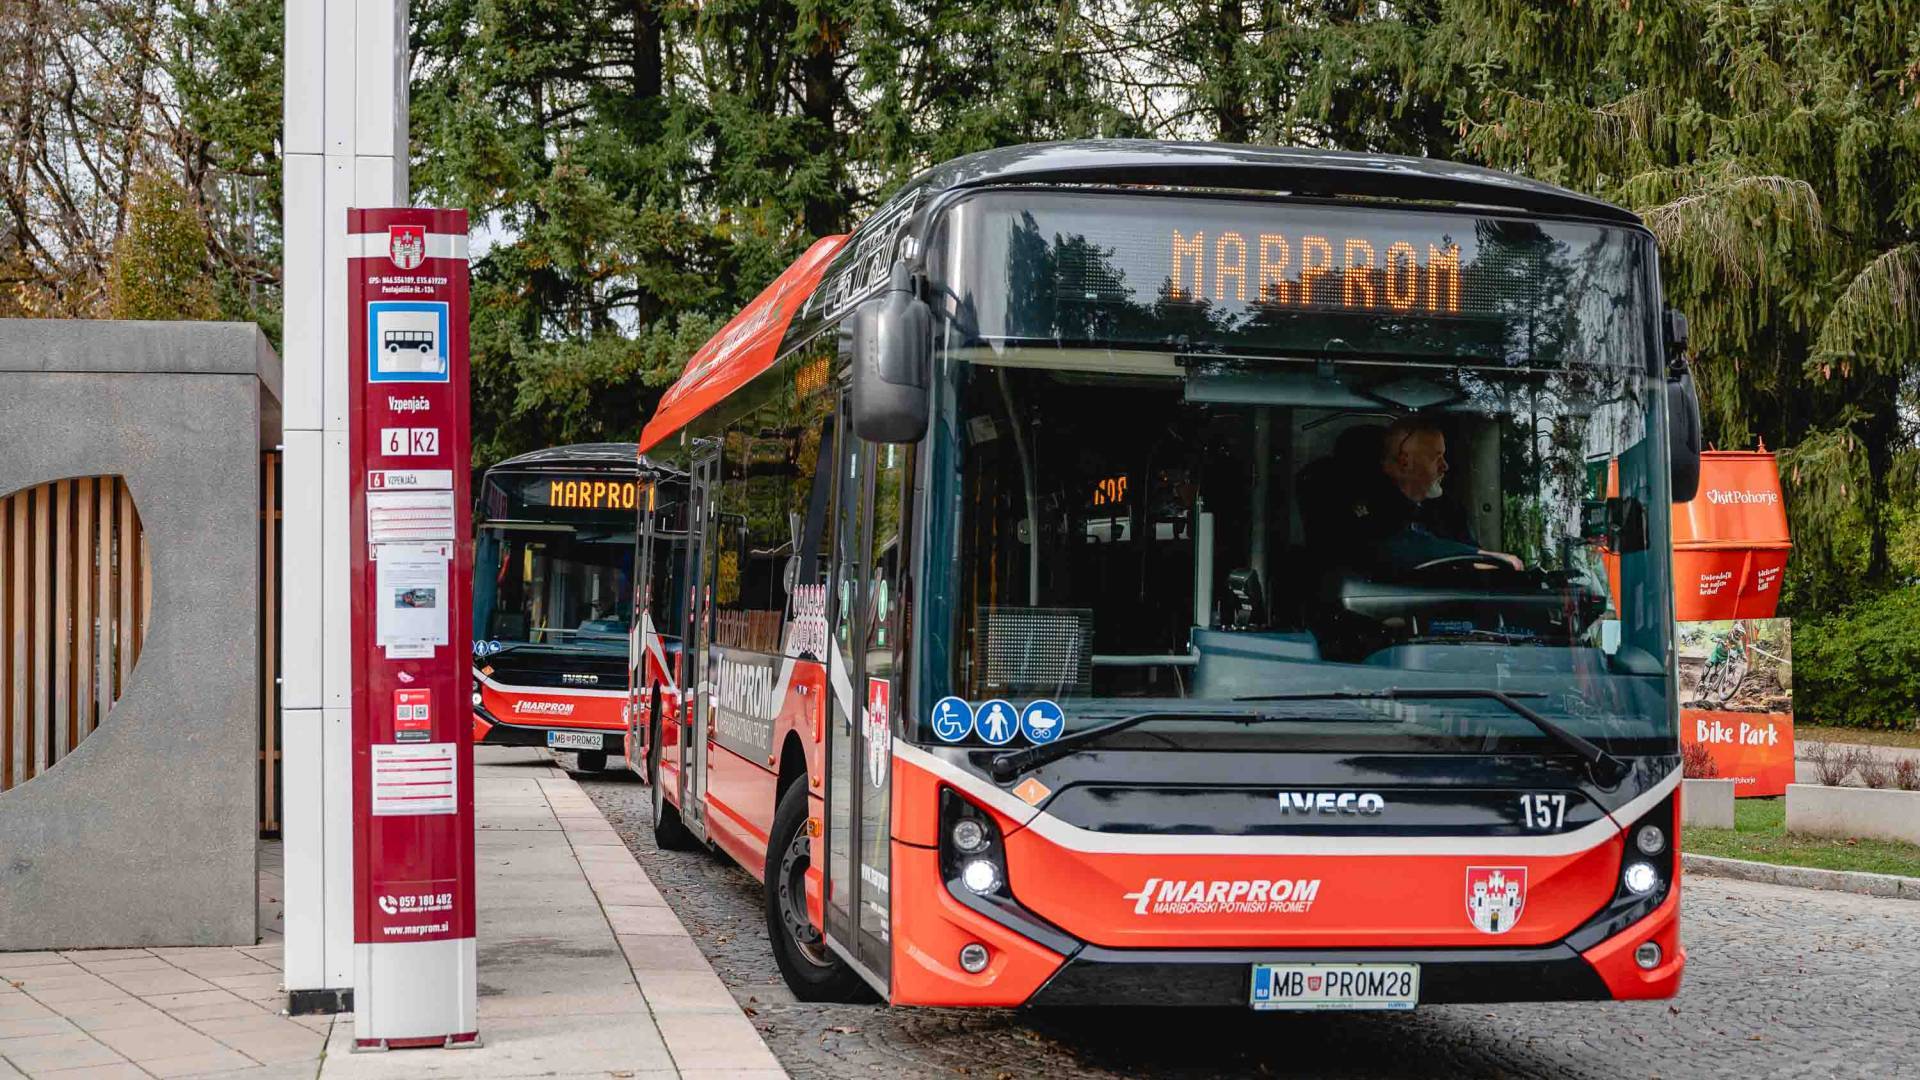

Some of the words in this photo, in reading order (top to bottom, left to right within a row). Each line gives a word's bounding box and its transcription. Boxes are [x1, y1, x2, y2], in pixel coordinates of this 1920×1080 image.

[1172, 229, 1460, 312] MARPROM
[388, 396, 430, 414] Vzpenjača
[390, 432, 398, 452] 6
[414, 432, 434, 452] K2
[373, 473, 380, 487] 6
[388, 474, 417, 485] VZPENJAČA
[562, 674, 598, 685] IVECO
[720, 659, 772, 720] MARPROM
[521, 702, 574, 712] MARPROM
[554, 733, 565, 744] MB
[571, 734, 601, 745] PROM32
[1696, 719, 1733, 743] Bike
[1739, 721, 1778, 746] Park
[1278, 792, 1385, 816] IVECO
[1519, 795, 1566, 828] 157
[399, 896, 416, 907] 059
[419, 894, 434, 906] 180
[1157, 880, 1321, 902] MARPROM
[1153, 901, 1218, 914] MARIBORSKI
[1219, 899, 1267, 913] POTNIŠKI
[1268, 901, 1313, 913] PROMET
[383, 921, 448, 936] www.marprom.si
[1272, 971, 1304, 997] MB
[1325, 971, 1411, 997] PROM28
